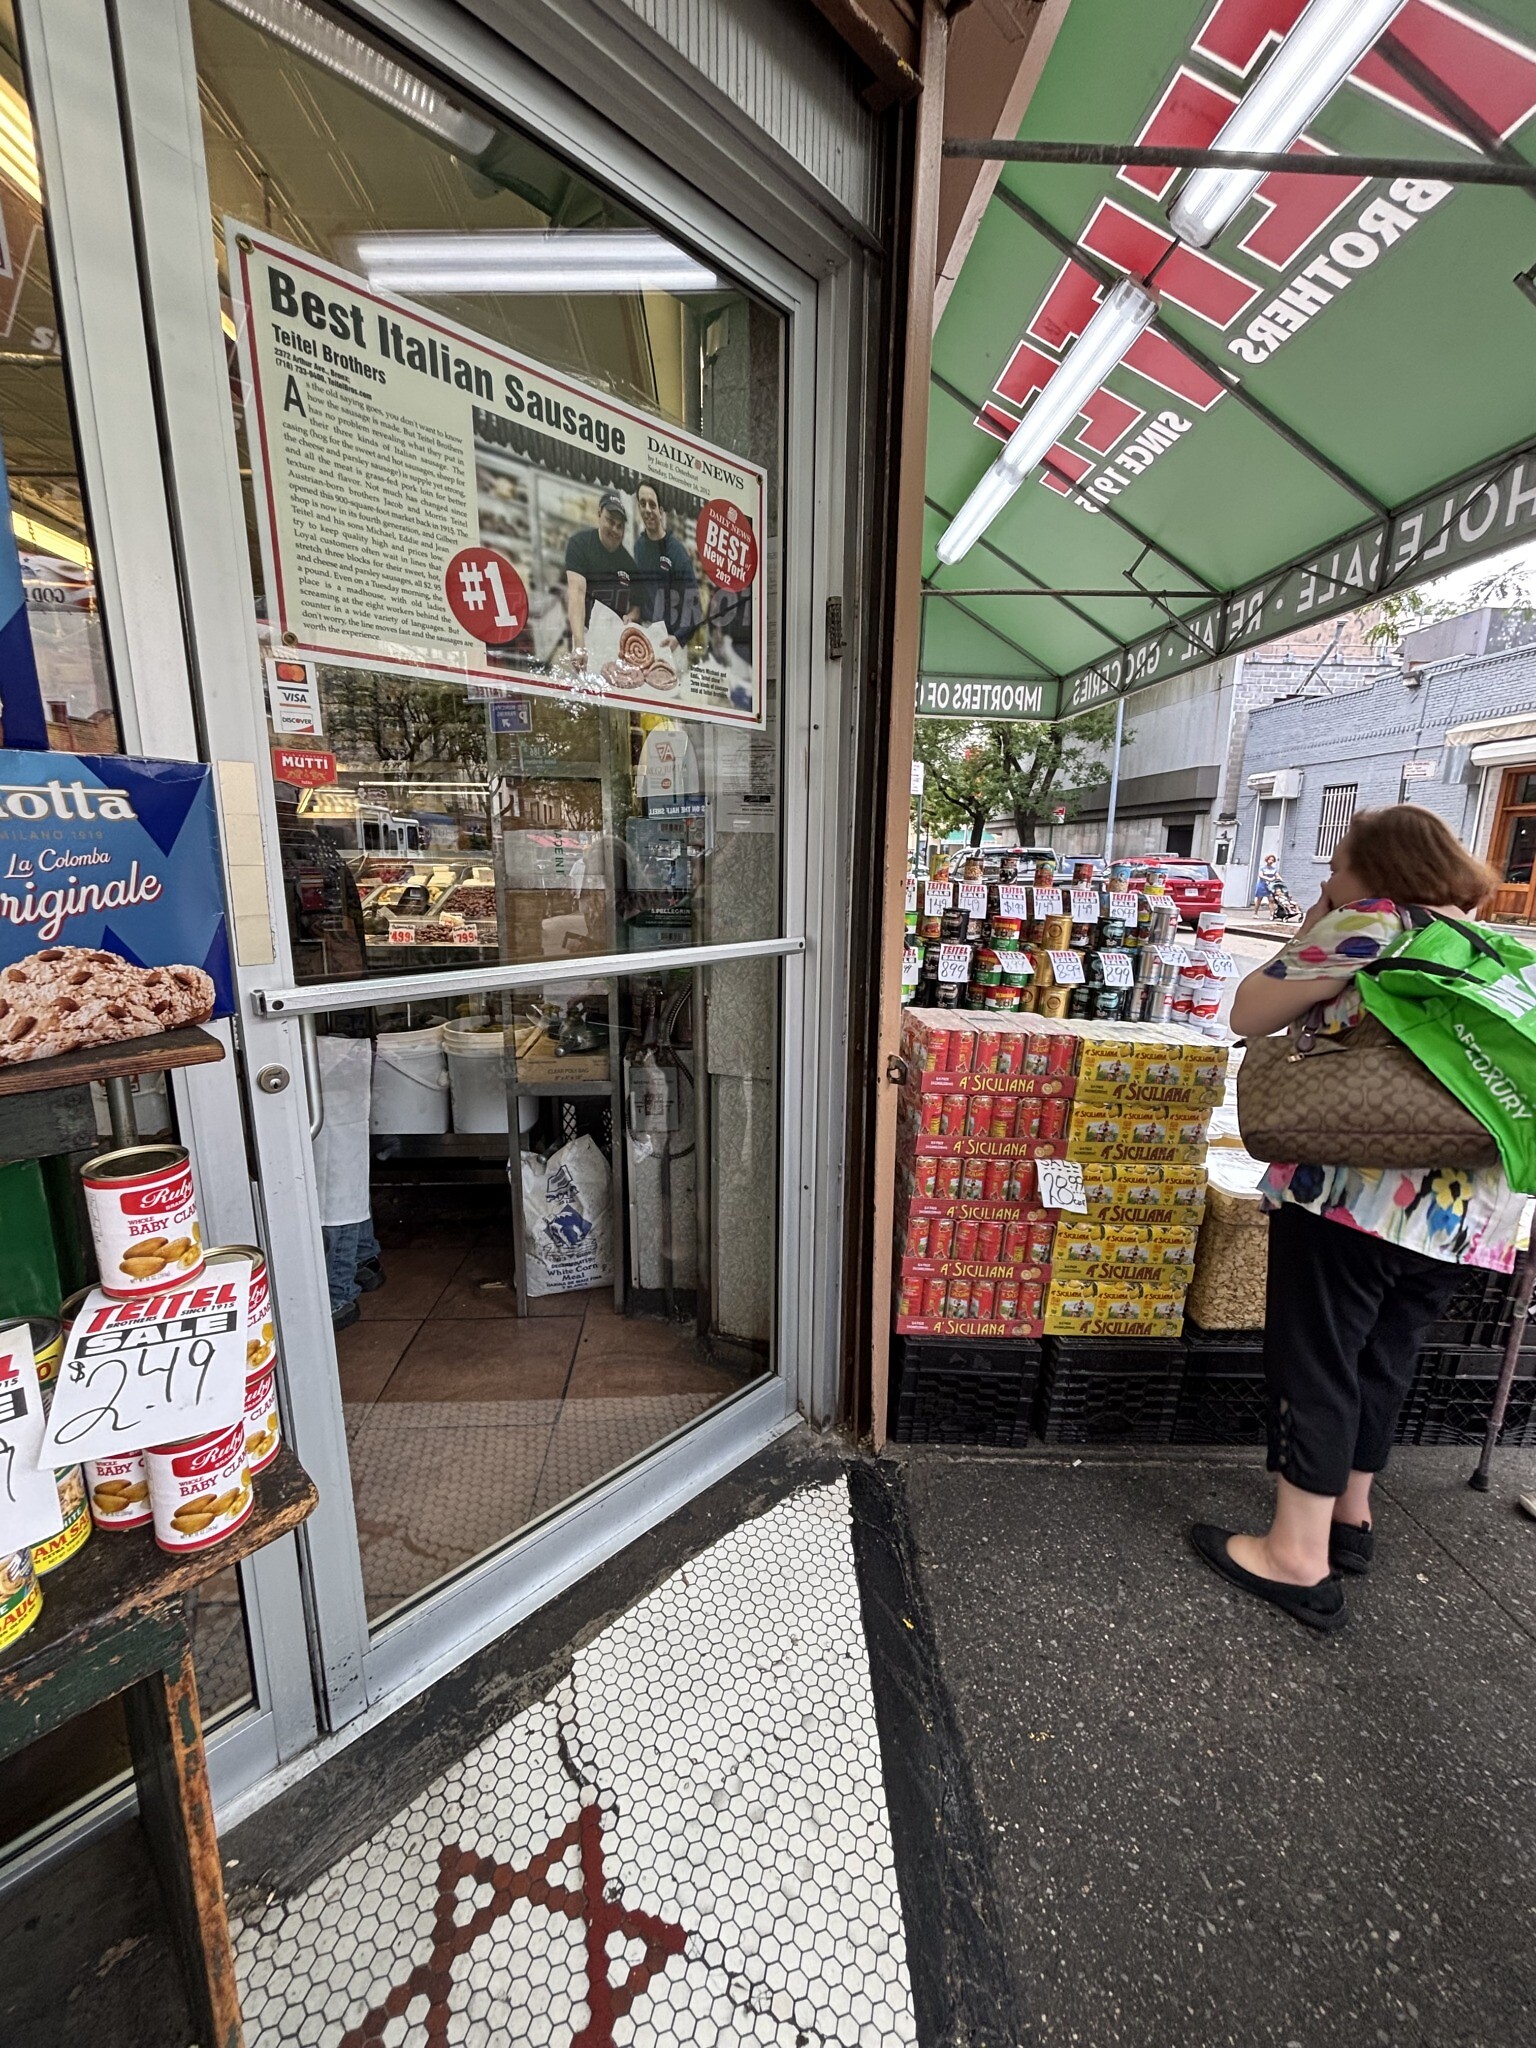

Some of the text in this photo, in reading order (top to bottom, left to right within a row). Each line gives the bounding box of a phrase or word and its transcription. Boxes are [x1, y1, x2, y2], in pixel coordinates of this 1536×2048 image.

[268, 266, 626, 455] Best Italian Sausage
[272, 323, 386, 385] Teitel Brothers
[647, 436, 743, 491] DAILY NEWS
[285, 444, 465, 507] and all the meat is grass-fed pork loin for better
[286, 456, 467, 517] texture and flavor. Not much has changed since
[709, 508, 731, 527] DAILY
[294, 528, 441, 571] Loyal customers often wait in lines that
[706, 519, 749, 567] BEST
[703, 543, 746, 583] New York
[715, 568, 731, 586] 2012
[459, 562, 518, 627] #1
[299, 587, 451, 624] screaming at the eight workers behind the
[282, 691, 307, 703] VISA
[282, 716, 312, 724] DISCOVER
[281, 755, 329, 770] MUTTI
[0, 780, 138, 820] otta
[4, 847, 112, 879] La Colomba
[927, 882, 951, 890] TEITEL
[0, 860, 162, 941] riginale
[391, 930, 411, 942] 499
[456, 932, 475, 944] 799
[943, 946, 968, 954] TEITEL
[941, 961, 966, 978] 899
[1212, 959, 1232, 973] 699
[959, 1076, 970, 1090] A'
[971, 1075, 1035, 1092] SICILIANA
[1126, 1082, 1192, 1103] SICILIANA
[953, 1140, 965, 1154] A'
[966, 1139, 1027, 1155] SICILIANA
[1113, 1143, 1177, 1161] SICILIANA
[140, 1179, 193, 1208] Ruby
[128, 1216, 154, 1226] WHOLE
[946, 1206, 958, 1216] A'
[959, 1204, 1020, 1220] SICILIANA
[1110, 1205, 1173, 1223] SICILIANA
[129, 1218, 170, 1236] BABY
[546, 1263, 598, 1277] White Corn
[562, 1272, 585, 1281] Meal
[940, 1263, 952, 1276] A'
[952, 1262, 1014, 1279] SICILIANA
[1099, 1263, 1162, 1280] SICILIANA
[86, 1283, 237, 1333] TEITEL
[106, 1302, 235, 1330] BROTHERS SINCE 1915
[85, 1313, 229, 1357] SALE
[933, 1321, 945, 1334] A'
[945, 1320, 1005, 1335] SICILIANA
[1091, 1319, 1153, 1336] SICILIANA
[244, 1378, 272, 1406] uby
[190, 1430, 244, 1471] Ruby
[97, 1462, 133, 1476] BABY
[179, 1476, 204, 1487] WHOLE
[180, 1475, 218, 1497] BABY
[34, 1533, 67, 1560] AM
